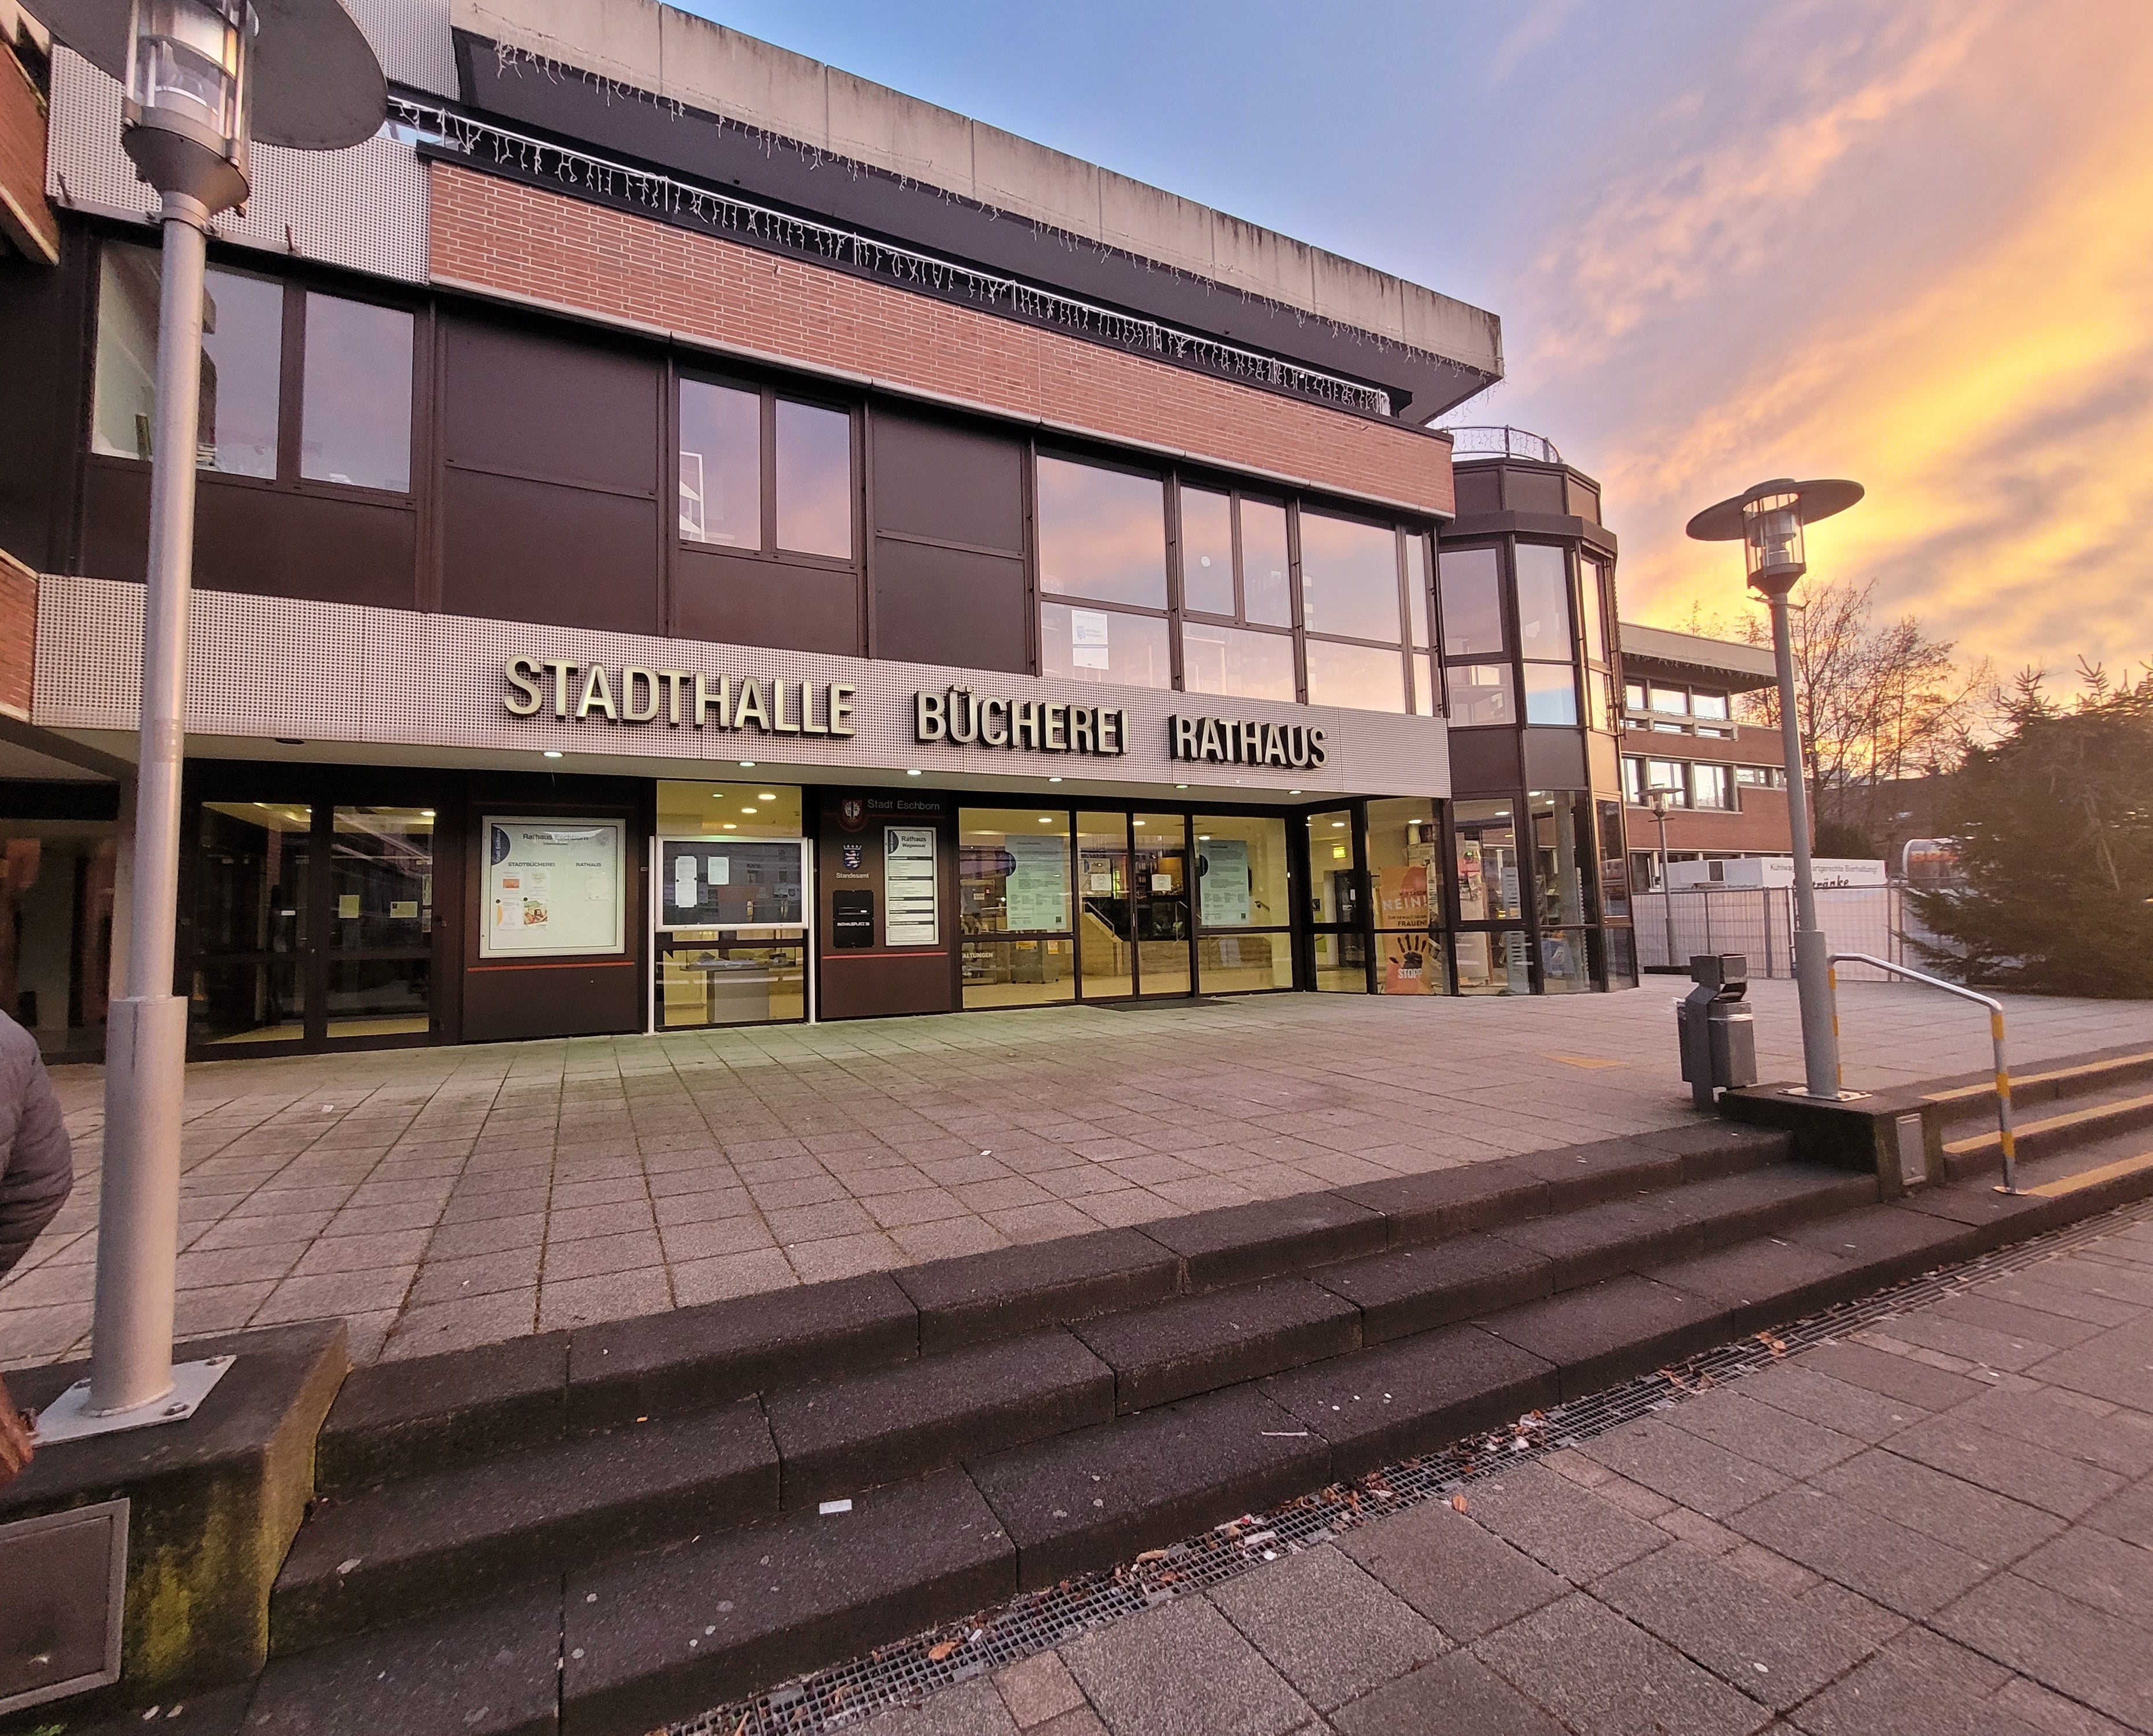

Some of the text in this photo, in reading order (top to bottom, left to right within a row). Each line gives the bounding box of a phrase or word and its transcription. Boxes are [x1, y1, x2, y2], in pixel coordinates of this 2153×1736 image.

[503, 654, 1329, 768] STADTHALLE BÜCHEREI RATHAUS
[868, 799, 940, 810] Stadt Eschborn
[1382, 895, 1427, 911] NEIN!
